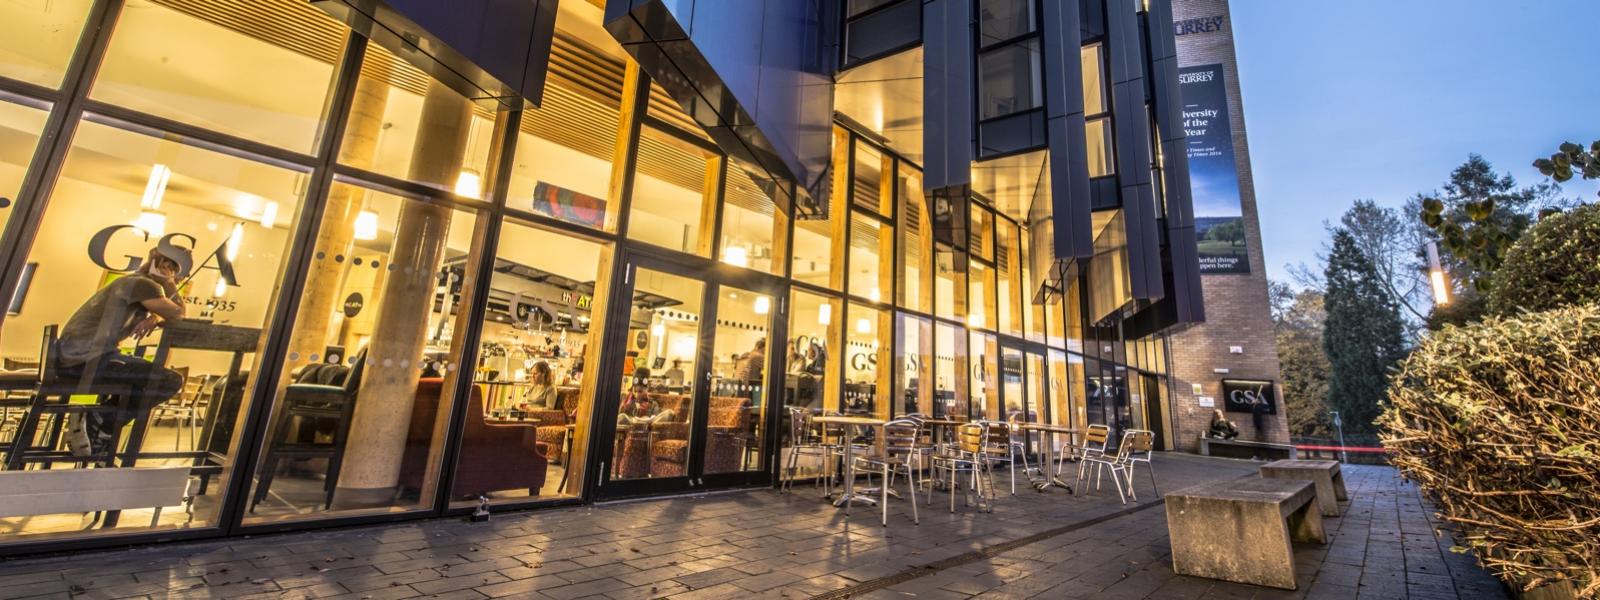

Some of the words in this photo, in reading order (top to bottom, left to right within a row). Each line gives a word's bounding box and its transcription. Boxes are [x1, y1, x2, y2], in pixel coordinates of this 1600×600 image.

[1179, 72, 1214, 84] SURREY
[1192, 119, 1208, 127] the
[1184, 129, 1206, 137] Year
[88, 222, 246, 301] GSA
[1217, 256, 1239, 264] things
[1230, 386, 1269, 406] GSA
